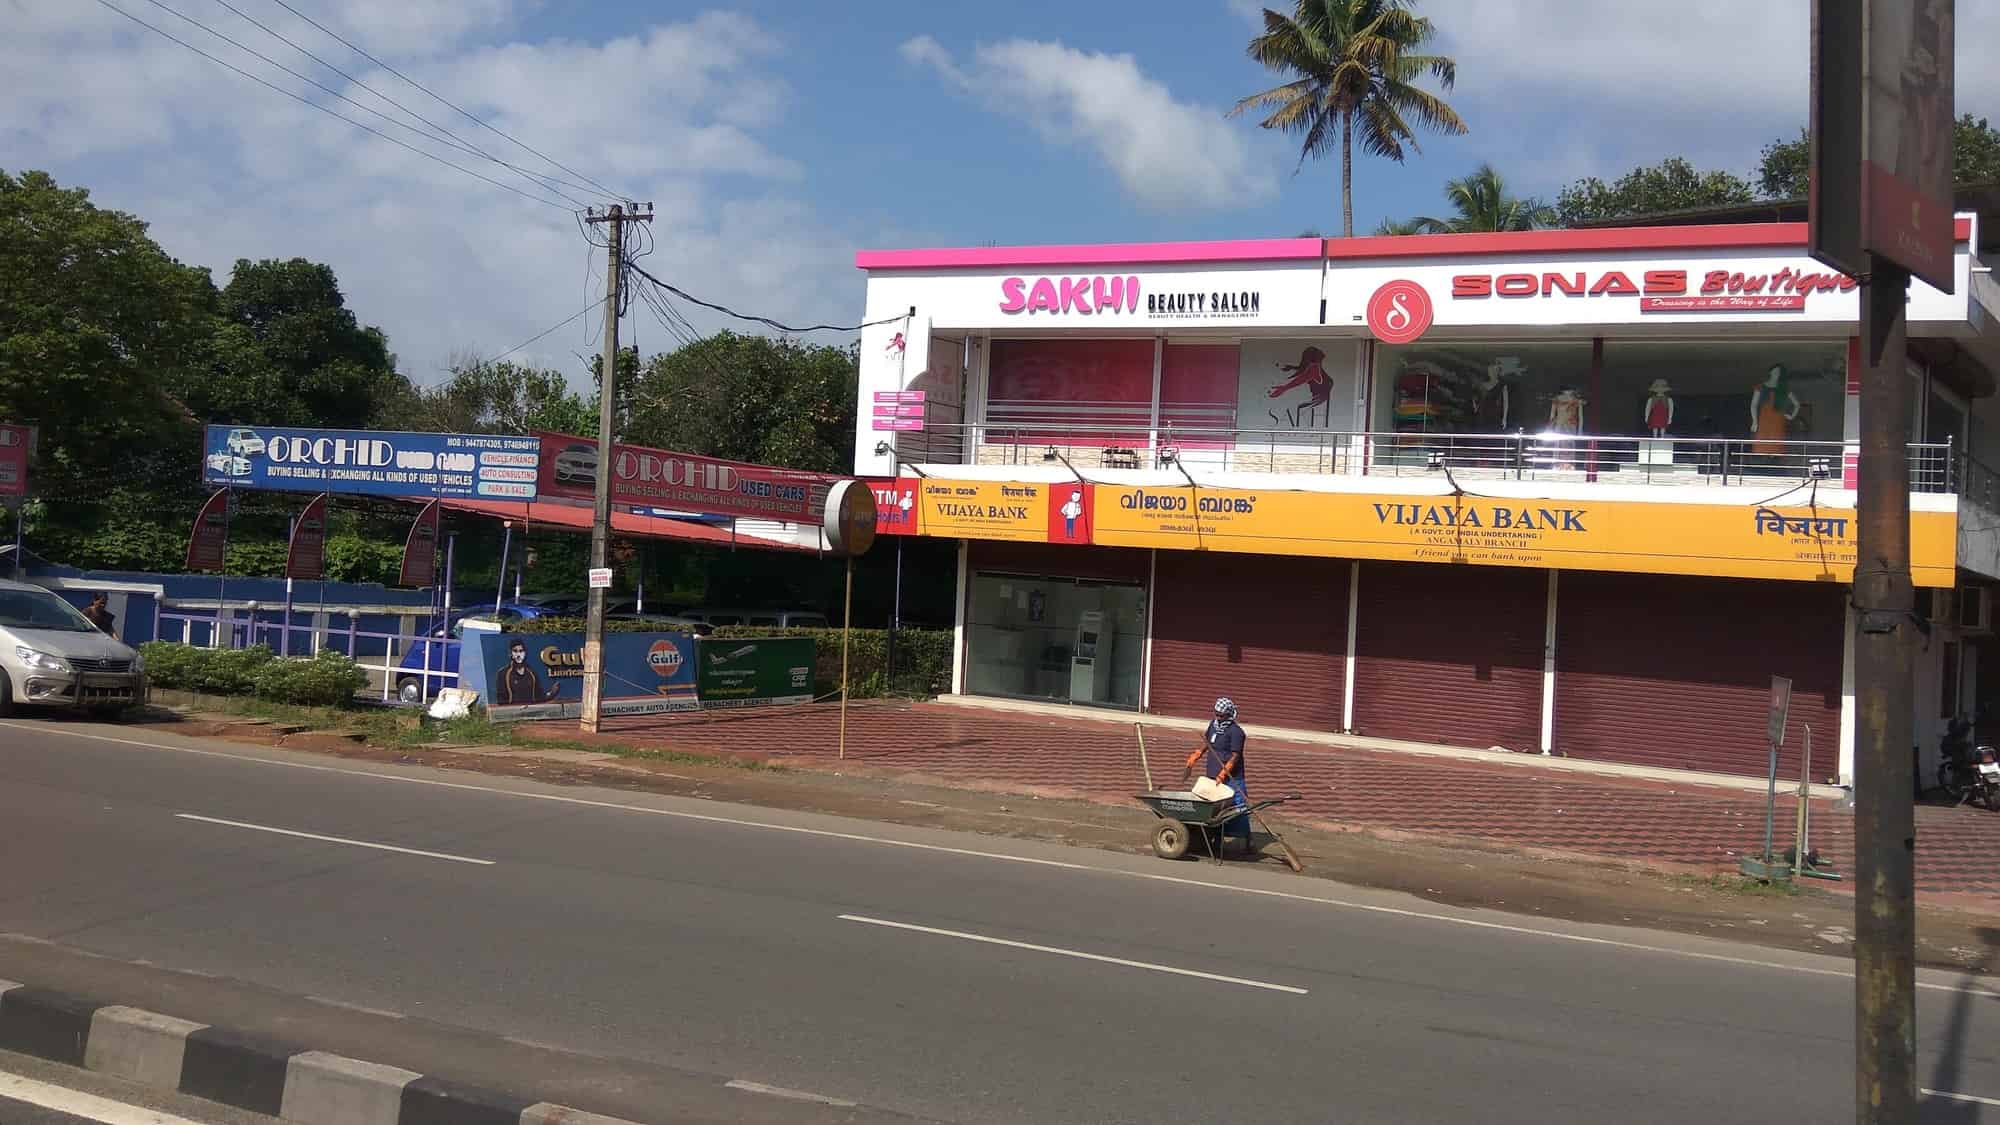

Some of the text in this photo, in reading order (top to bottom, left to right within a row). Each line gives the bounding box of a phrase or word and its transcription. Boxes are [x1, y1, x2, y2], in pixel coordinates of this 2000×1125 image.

[1451, 267, 1858, 299] SONAS Boutique
[999, 276, 1140, 315] SAKHI
[1148, 291, 1260, 313] BEAUTY SALON
[1710, 297, 1725, 305] the
[1730, 297, 1754, 307] Way
[1757, 297, 1769, 307] of
[1772, 297, 1793, 306] Life
[267, 436, 393, 467] ORCHID
[267, 466, 291, 477] BUYING
[293, 467, 320, 478] SELLING
[328, 469, 371, 481] EXCHANGING
[372, 471, 385, 481] ALL
[386, 472, 407, 482] KINDS
[408, 473, 418, 482] OF
[420, 473, 437, 484] USED
[439, 474, 473, 486] VEHICLES
[615, 451, 739, 491] ORCHID
[740, 479, 772, 497] USED
[775, 484, 806, 500] CARS
[871, 489, 898, 505] TM
[937, 503, 1028, 519] VIJAYA BANK
[1372, 503, 1588, 532] VIJAYA BANK
[1755, 507, 1848, 537] विजया
[540, 645, 586, 666] Gul
[650, 653, 679, 664] Gulf
